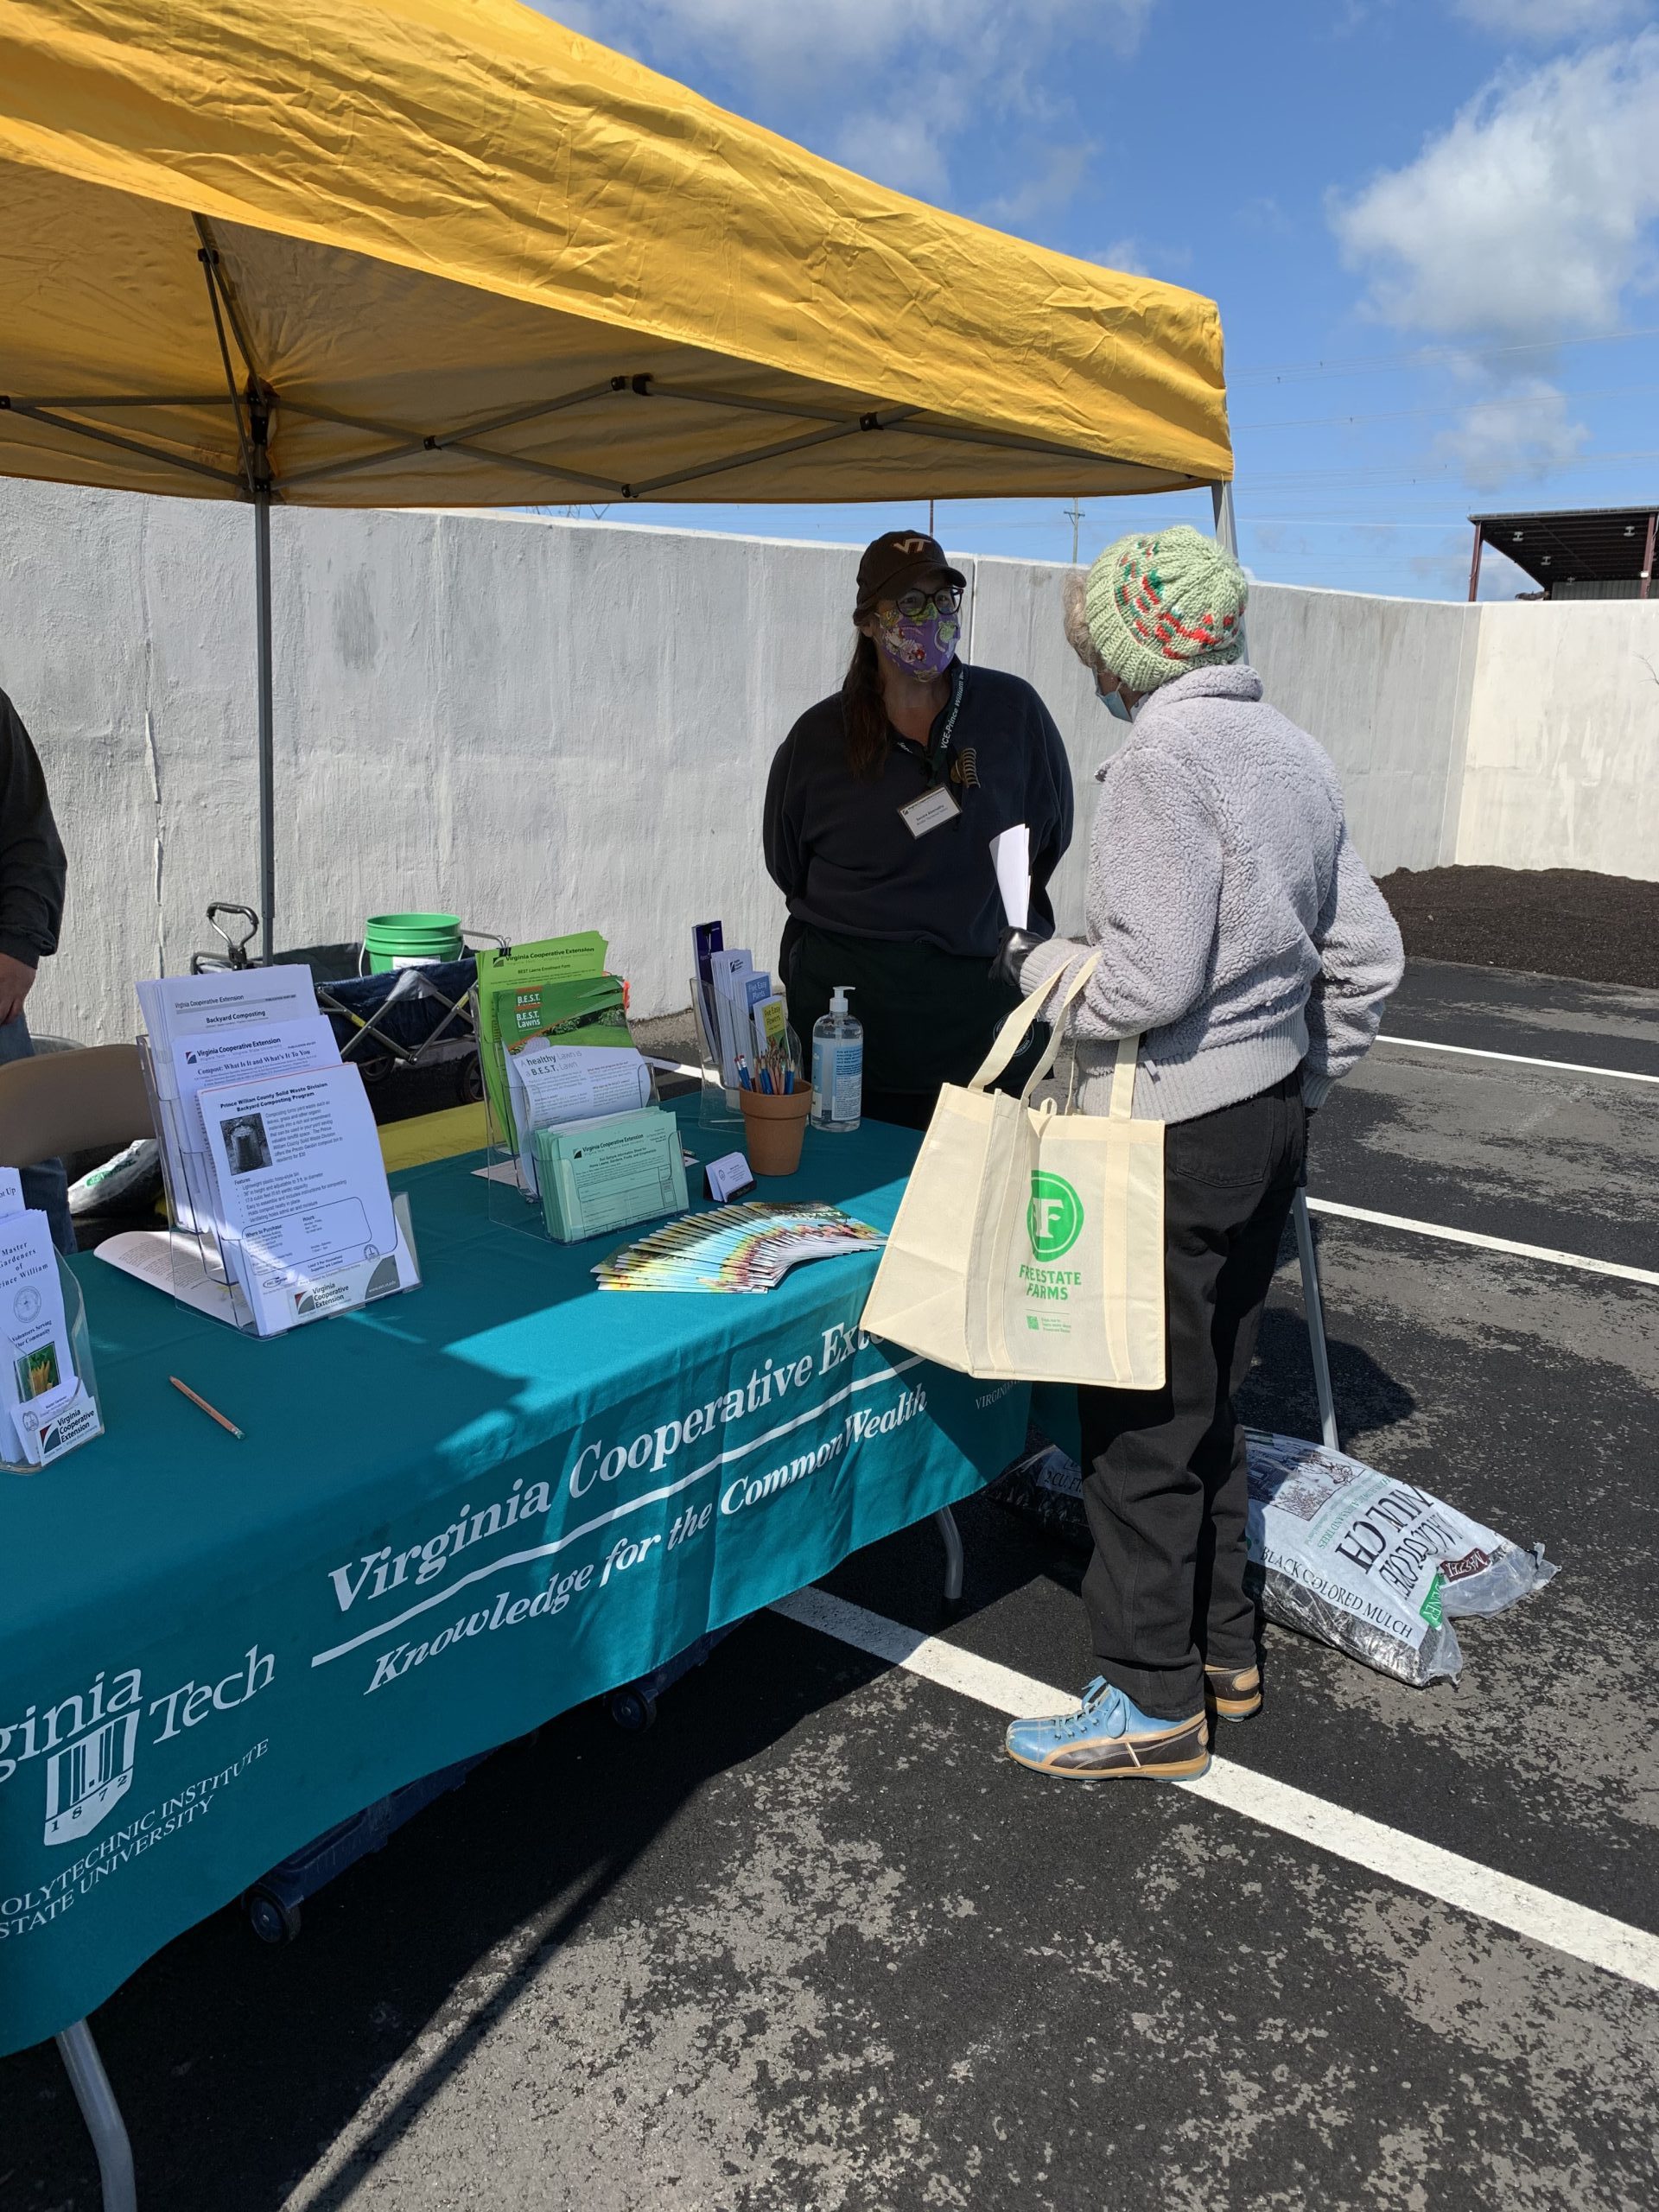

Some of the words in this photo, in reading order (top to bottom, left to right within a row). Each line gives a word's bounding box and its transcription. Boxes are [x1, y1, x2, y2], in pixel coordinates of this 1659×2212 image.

[893, 538, 931, 553] VT
[940, 709, 958, 748] VCE-Prince
[955, 681, 963, 706] William
[531, 950, 565, 959] Cooperative
[190, 997, 219, 1007] Cooperative
[219, 995, 244, 1004] Extension
[518, 994, 540, 1003] B.E.S.T.
[207, 1014, 232, 1024] Backyard
[232, 1010, 266, 1020] Composting
[517, 1011, 539, 1020] B.E.S.T.
[518, 1019, 540, 1028] Lawns
[197, 1048, 219, 1057] Virginia
[219, 1041, 251, 1053] Cooperative
[252, 1037, 281, 1047] Extension
[526, 1054, 556, 1065] healthy
[197, 1065, 223, 1075] Compost:
[531, 1066, 559, 1076] B.E.S.T.
[257, 1092, 275, 1101] County
[307, 1082, 327, 1090] Division
[237, 1103, 259, 1112] Backyard
[260, 1096, 291, 1107] Composting
[292, 1091, 315, 1101] Program
[601, 1140, 624, 1148] Cooperative
[625, 1134, 644, 1142] Extension
[6, 1187, 16, 1196] Up
[1033, 1198, 1064, 1238] F
[263, 1224, 283, 1232] Purchase:
[3, 1242, 28, 1255] Master
[19, 1263, 48, 1278] William
[312, 1282, 335, 1294] Virginia
[314, 1286, 349, 1301] Cooperative
[1026, 1283, 1068, 1300] FARMS
[315, 1295, 345, 1309] Extension
[12, 1327, 35, 1342] Volunteers
[35, 1319, 53, 1332] Serving
[16, 1339, 26, 1348] Our
[25, 1328, 50, 1344] Community
[57, 1409, 81, 1426] Virginia
[60, 1410, 94, 1434] Cooperative
[61, 1421, 90, 1443] Extension
[327, 1478, 552, 1612] Virginia
[569, 1357, 813, 1499] Cooperative
[1044, 1471, 1052, 1483] 2
[1052, 1473, 1066, 1487] CU.
[1335, 1485, 1433, 1575] MULCH
[1318, 1529, 1336, 1548] TREES
[363, 1563, 595, 1695] Knowledge
[599, 1534, 662, 1589] for
[667, 1500, 711, 1551] the
[1262, 1547, 1302, 1580] BLACK
[1302, 1570, 1364, 1612] COLORED
[1362, 1602, 1413, 1638] MULCH
[149, 1643, 276, 1745] Tech
[1, 1808, 156, 1916] OLYTECHNIC
[160, 1738, 270, 1820] INSTITUTE
[0, 1888, 75, 1939] STATE
[80, 1794, 215, 1895] UNIVERSITY
